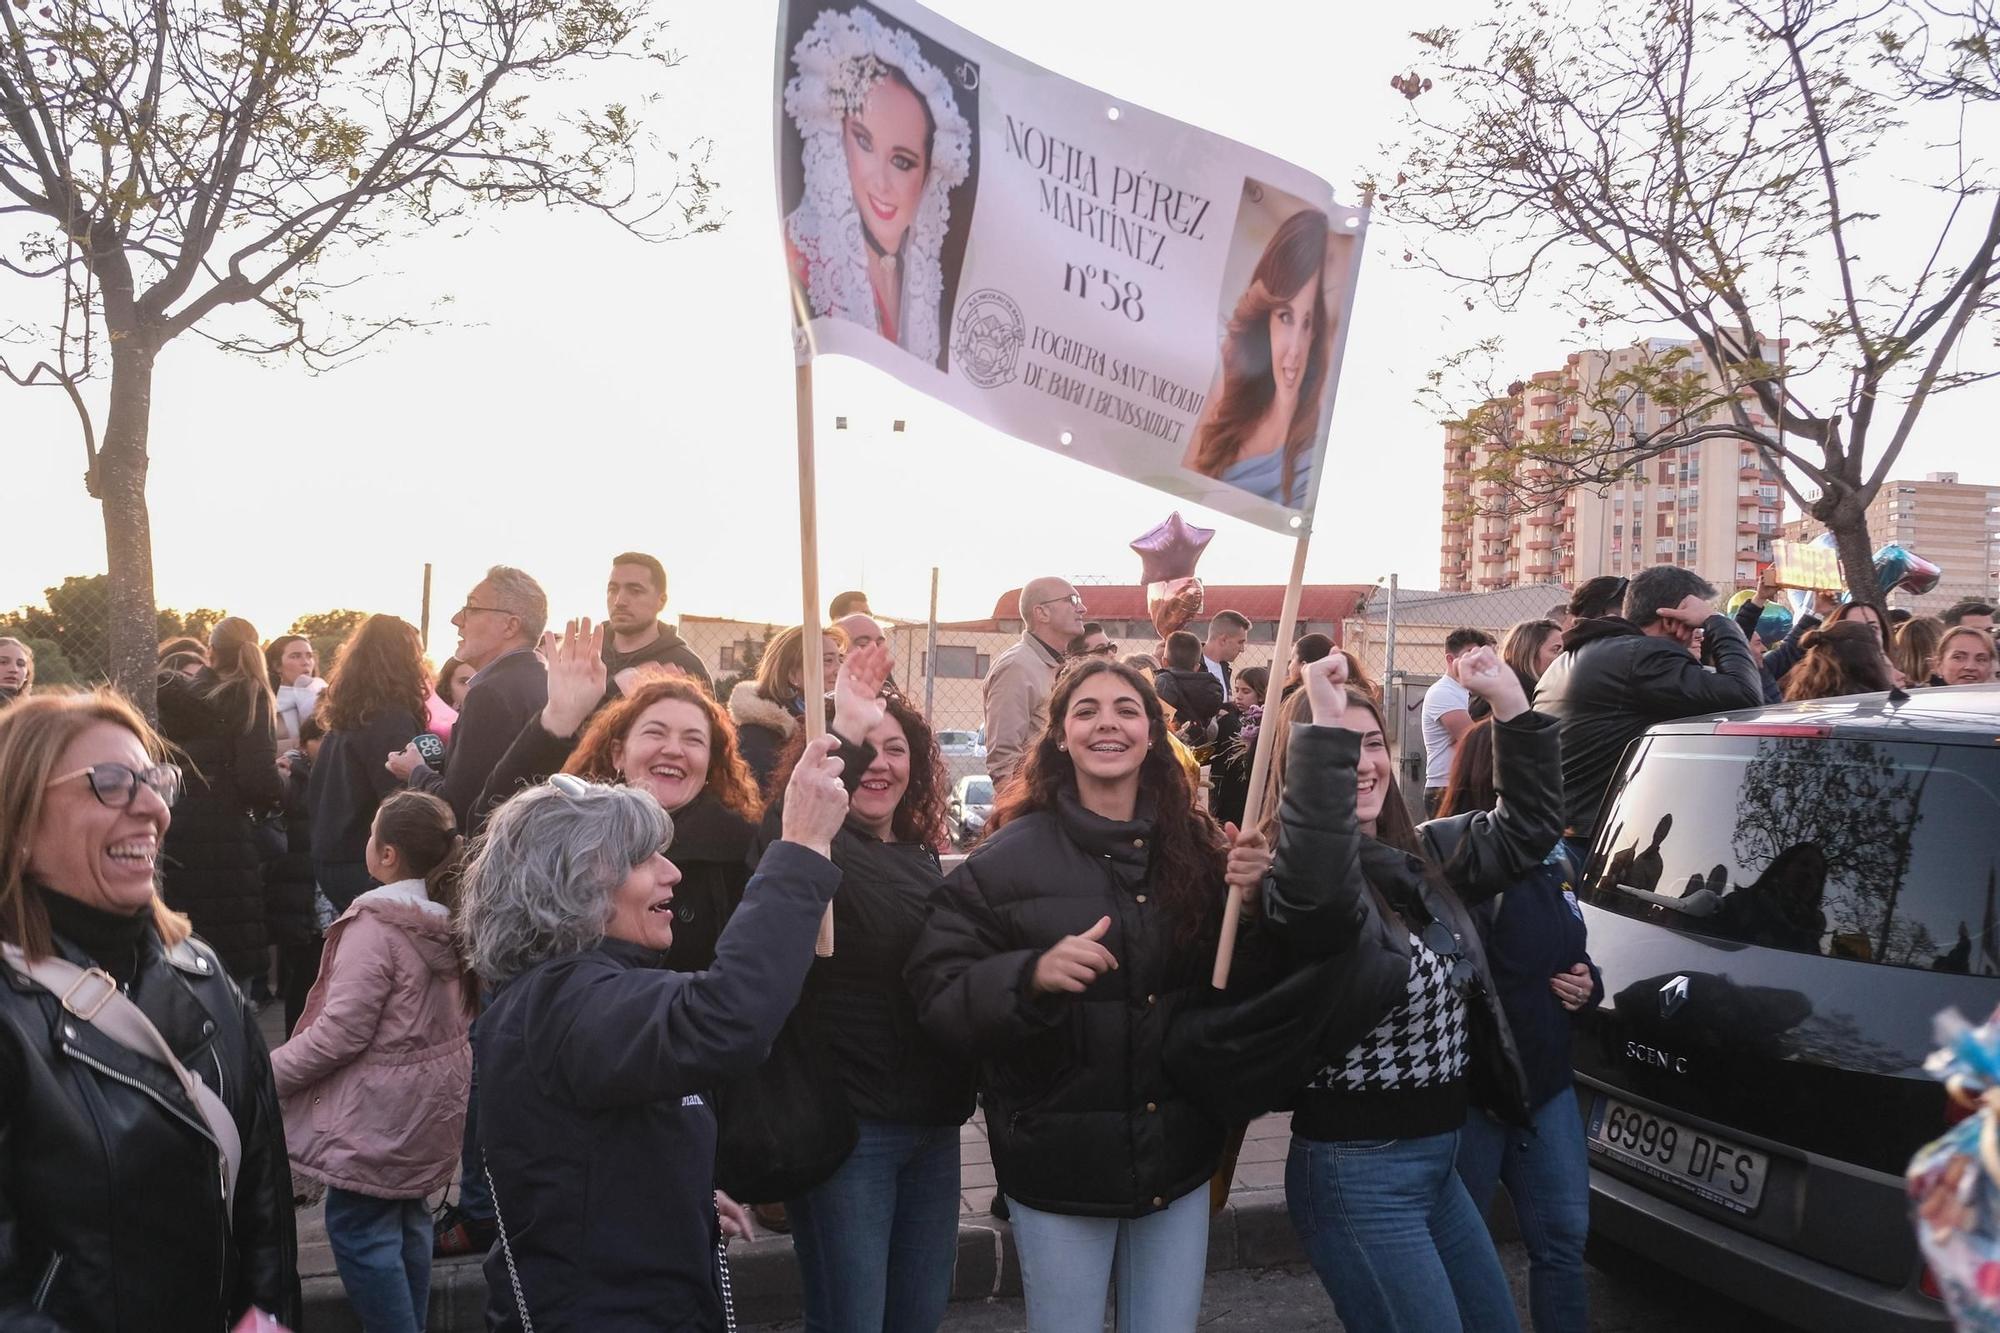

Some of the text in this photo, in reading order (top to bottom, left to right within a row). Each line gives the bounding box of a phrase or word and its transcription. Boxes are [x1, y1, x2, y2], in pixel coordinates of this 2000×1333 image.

[1005, 114, 1210, 241] NOELIA PÉREZ
[1039, 177, 1166, 270] MARTÍNEZ
[1023, 362, 1048, 391] DE
[1047, 372, 1086, 405] BARI
[1085, 387, 1095, 409] I
[1094, 390, 1185, 443] BENISSAUDET
[1031, 326, 1106, 376] FOGUERA
[1109, 359, 1149, 392] SANT
[1149, 375, 1205, 415] NICOLAU
[1607, 1106, 1678, 1164] 6999
[1687, 1136, 1753, 1195] DFS
